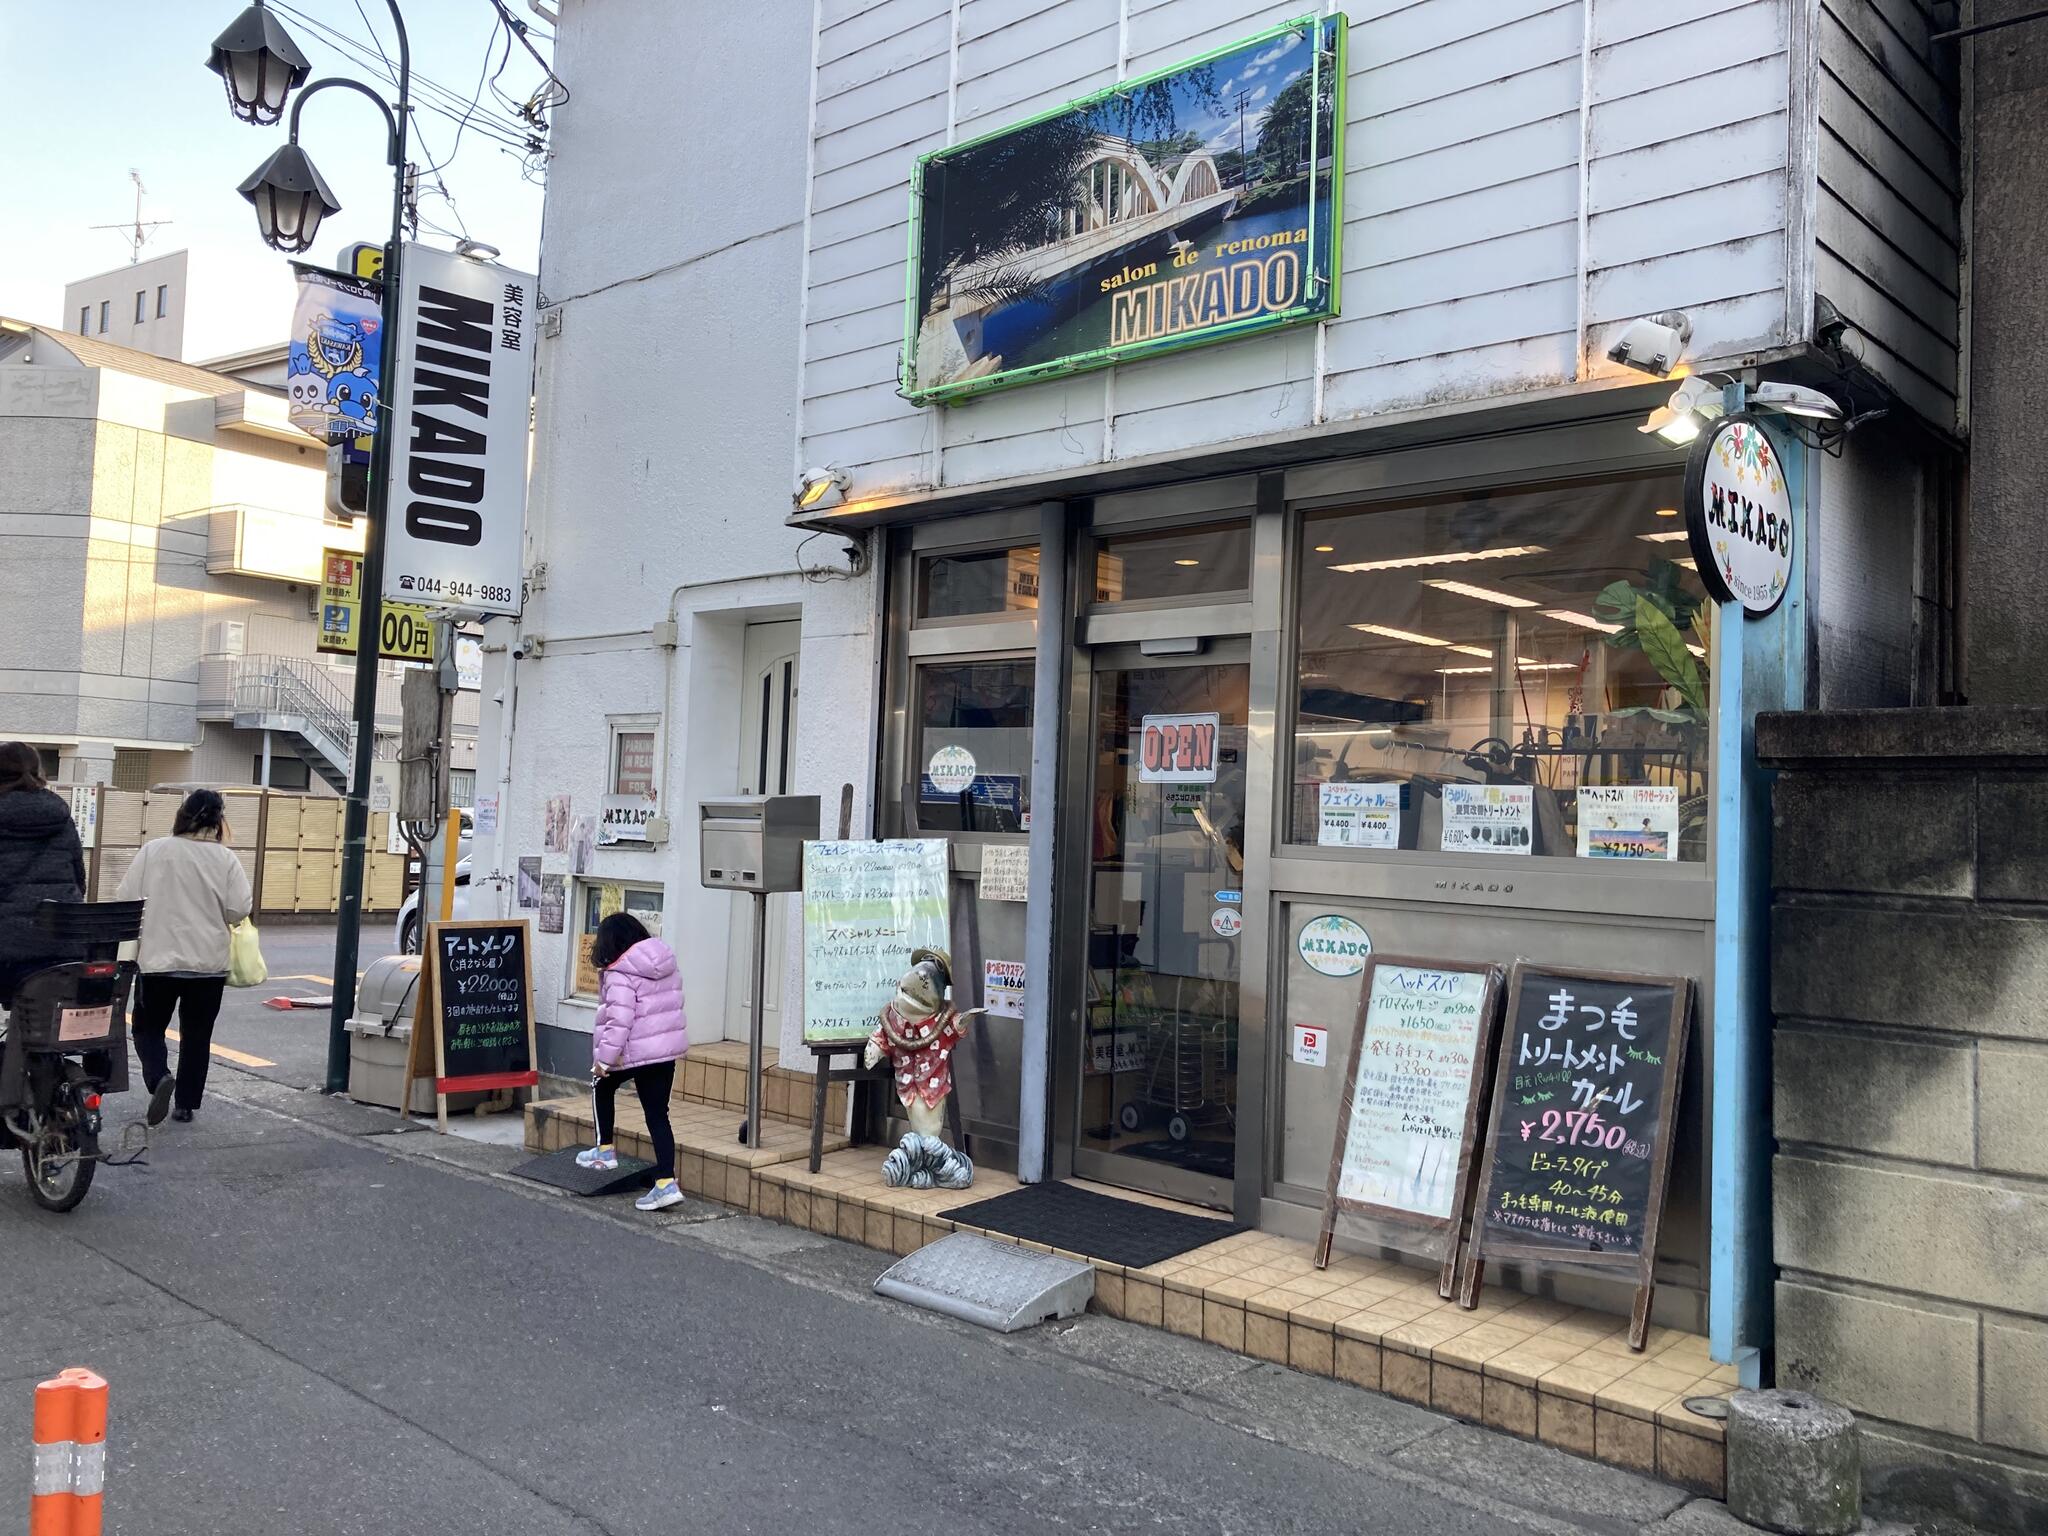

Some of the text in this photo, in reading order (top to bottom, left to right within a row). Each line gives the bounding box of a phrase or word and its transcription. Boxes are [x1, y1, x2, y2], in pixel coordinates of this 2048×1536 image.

[1101, 227, 1308, 293] salon de renoma
[1110, 250, 1300, 347] MIKADO
[502, 283, 524, 352] 美容室
[406, 285, 495, 547] MIKADO
[1708, 481, 1791, 558] MIKADO
[417, 576, 512, 602] 044-944-9883
[1733, 575, 1752, 600] since
[1143, 723, 1216, 772] OPEN
[931, 764, 974, 777] MIKADO
[1323, 793, 1385, 807] フェイシャル
[1591, 789, 1624, 802] ヘッドスパ
[1633, 789, 1676, 803] リラクゼーション
[445, 935, 516, 957] アートメーク
[1302, 938, 1369, 957] MIKADO
[1390, 973, 1460, 993] ヘッドスパ
[1538, 989, 1638, 1040] まつ毛
[1300, 1046, 1320, 1057] PayPay
[1519, 1033, 1626, 1075] トリートメント
[1571, 1078, 1644, 1115] カール
[1520, 1110, 1627, 1150] ¥2,750
[1622, 1138, 1651, 1160] (税込)
[1531, 1152, 1609, 1179] ビューラータイプ
